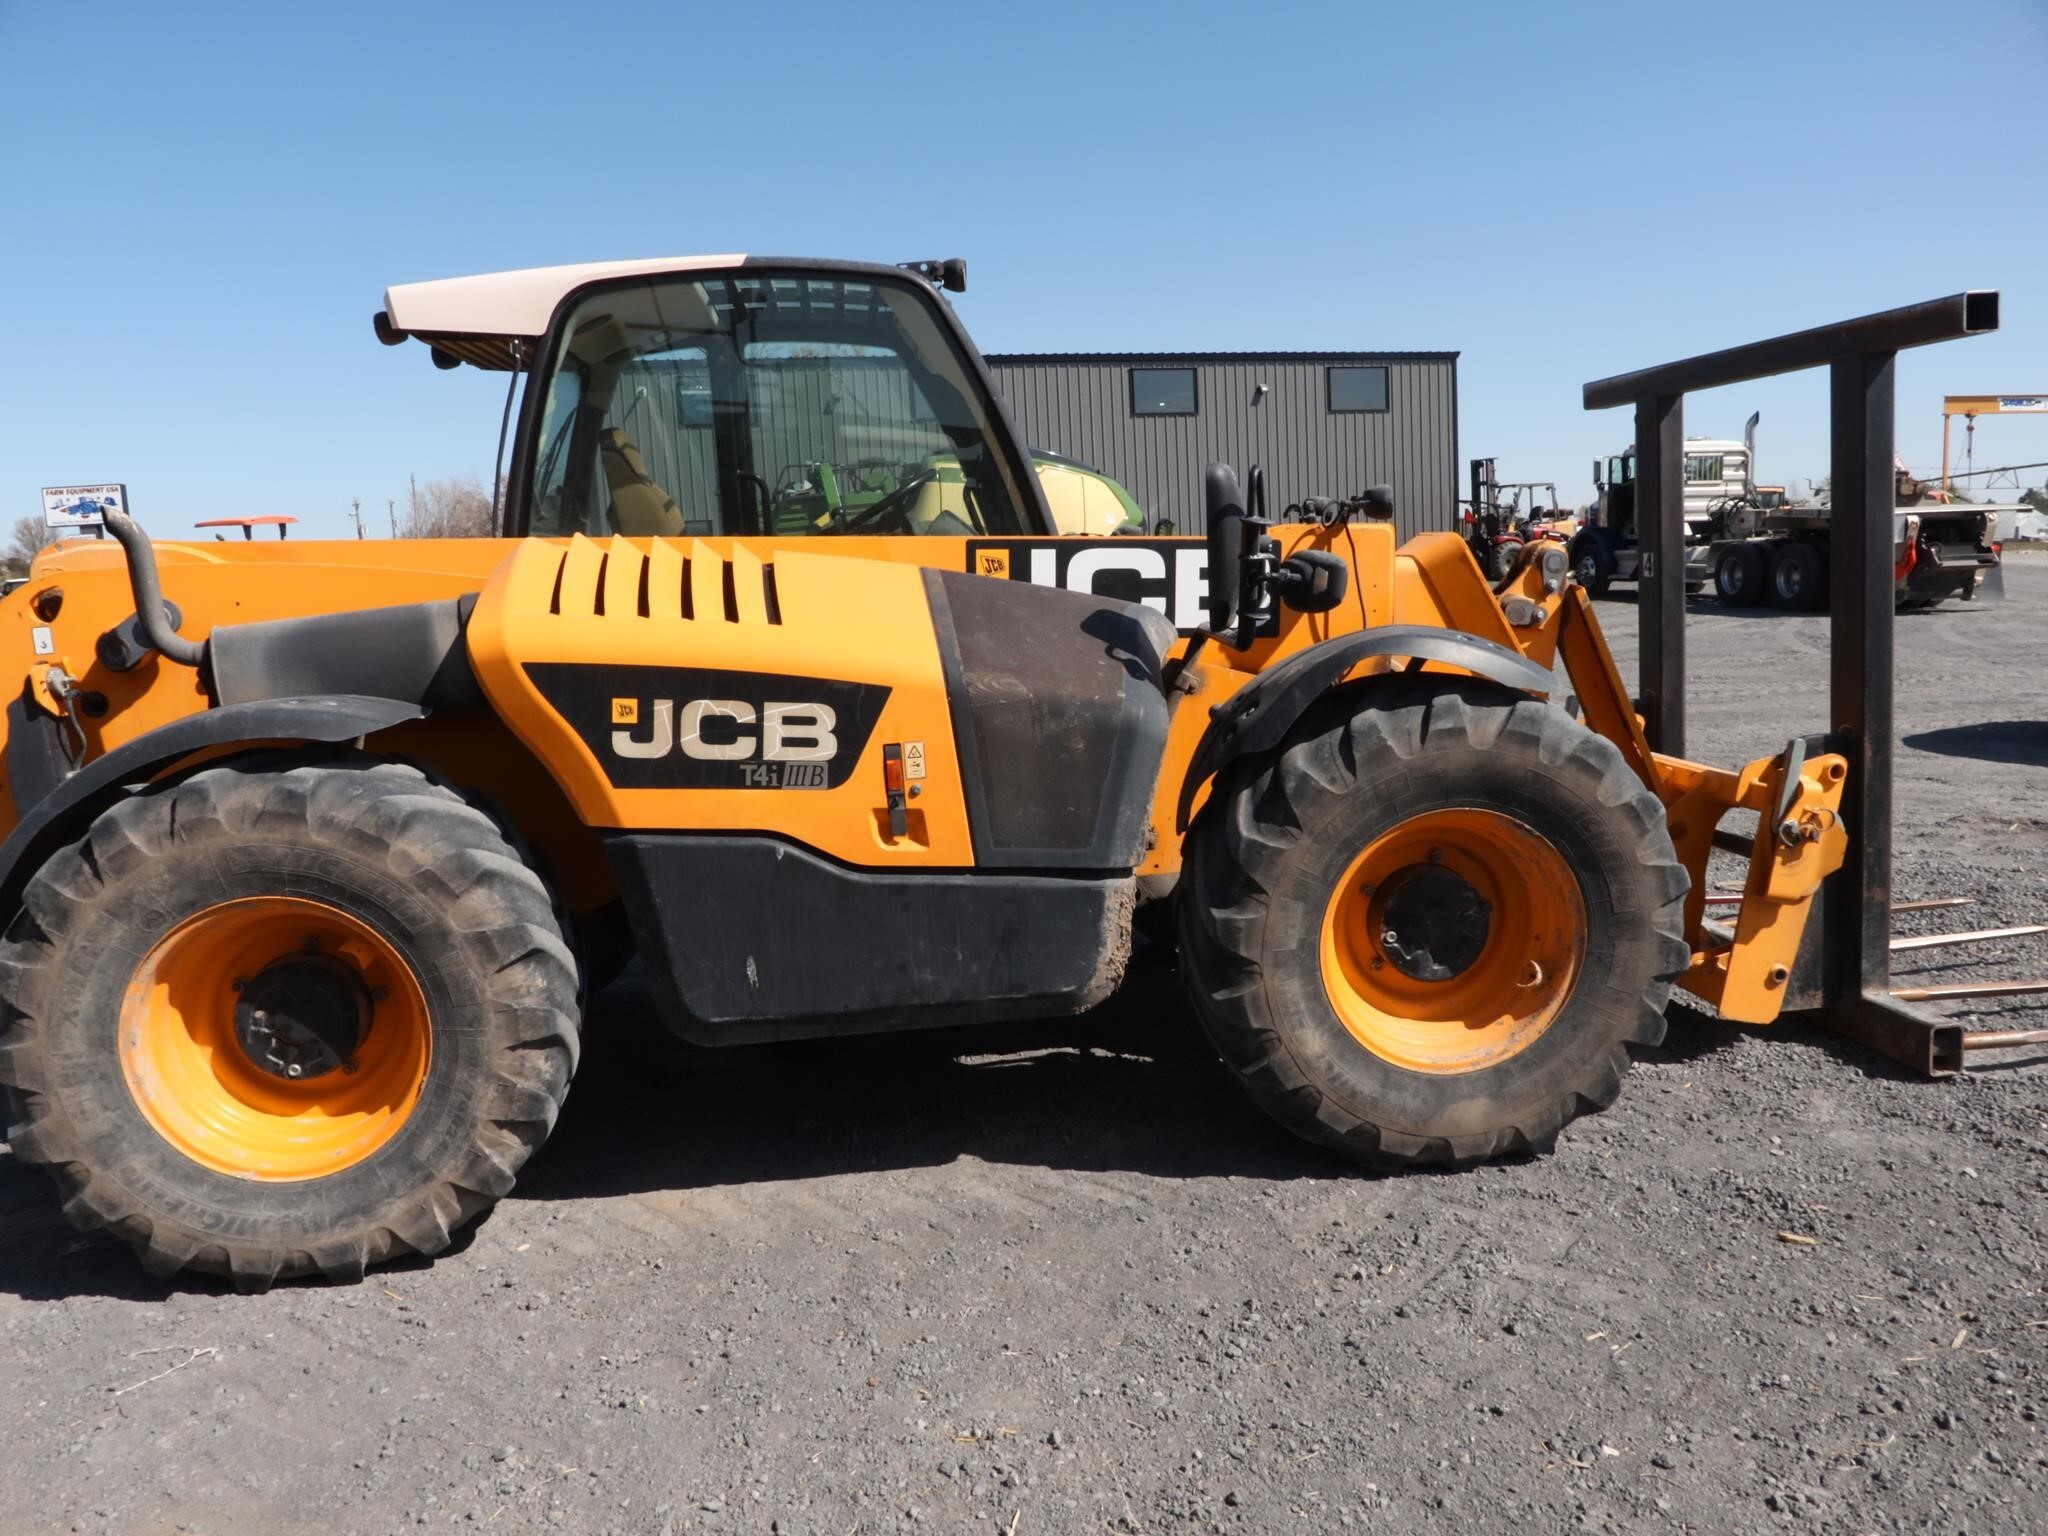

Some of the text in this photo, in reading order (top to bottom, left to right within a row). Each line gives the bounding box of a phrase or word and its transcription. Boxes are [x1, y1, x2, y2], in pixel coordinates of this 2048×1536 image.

[66, 487, 104, 495] EQUIPMENT
[985, 558, 1004, 573] JCB
[612, 698, 838, 761] JCB
[740, 764, 780, 787] T4i
